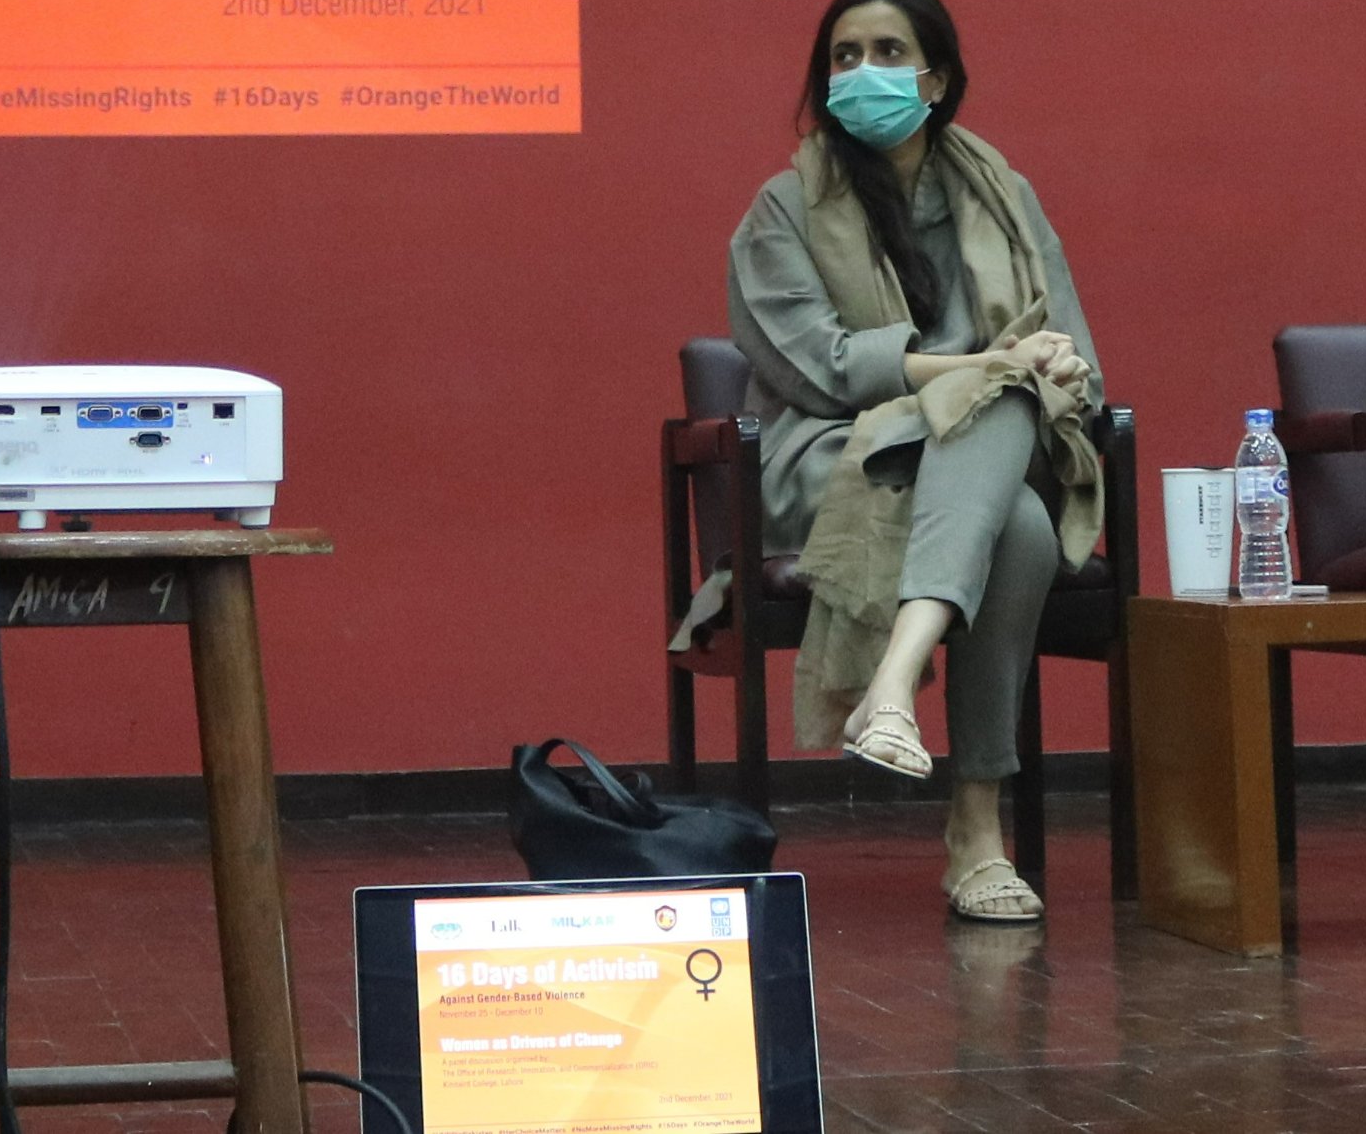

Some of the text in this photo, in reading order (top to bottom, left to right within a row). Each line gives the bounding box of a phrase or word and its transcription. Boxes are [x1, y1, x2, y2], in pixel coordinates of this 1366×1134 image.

[213, 87, 320, 111] #16Days
[339, 85, 561, 111] #OrangeTheWorld
[437, 956, 659, 990] 16 Days of Activism
[439, 994, 475, 1007] Against
[545, 990, 586, 1002] Violence
[440, 1031, 623, 1053] Women as Drivers of Change
